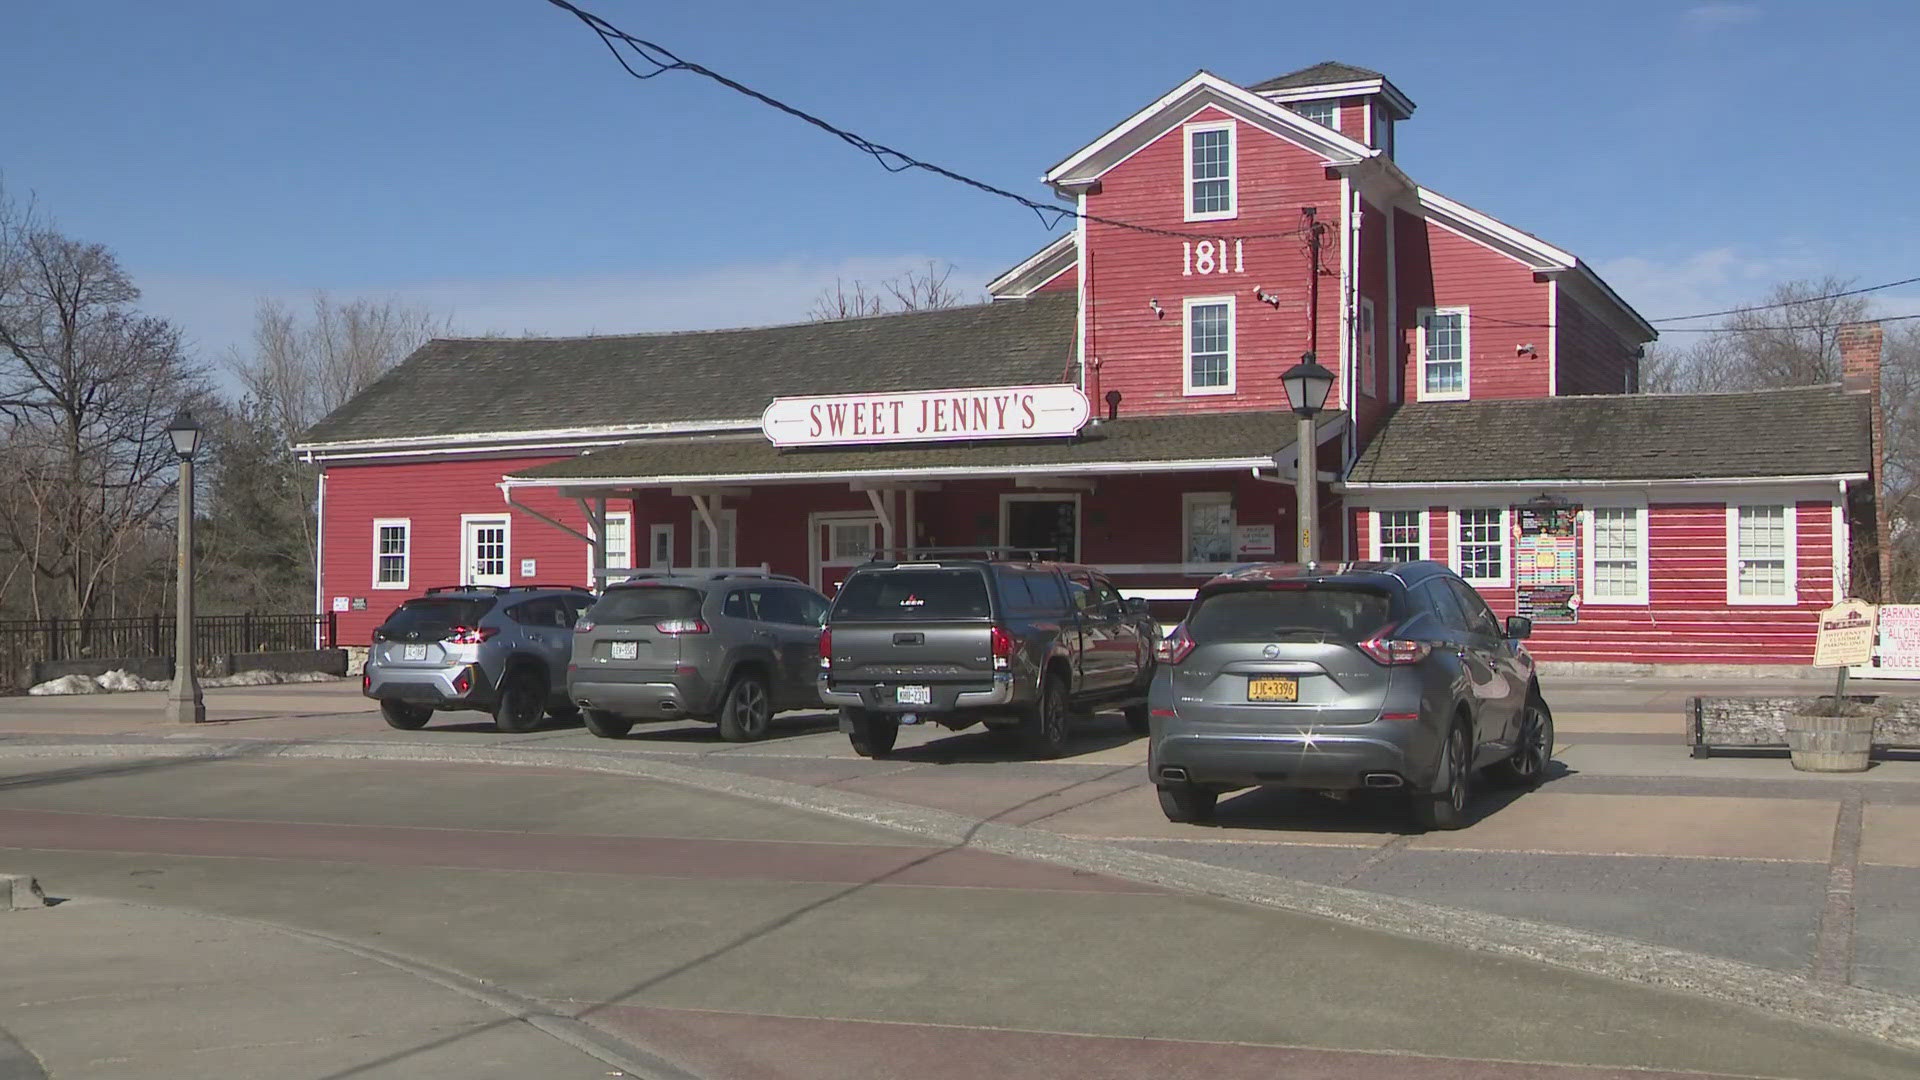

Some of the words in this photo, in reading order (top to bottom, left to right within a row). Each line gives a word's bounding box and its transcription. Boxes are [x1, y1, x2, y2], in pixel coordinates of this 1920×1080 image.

[1182, 239, 1244, 276] 1811
[809, 400, 904, 437] SWEET
[916, 393, 1036, 433] JENNY'S
[1881, 607, 1920, 618] PARKING
[1888, 628, 1902, 639] ALL
[1903, 628, 1920, 639] OTH
[1882, 656, 1912, 667] POLICE
